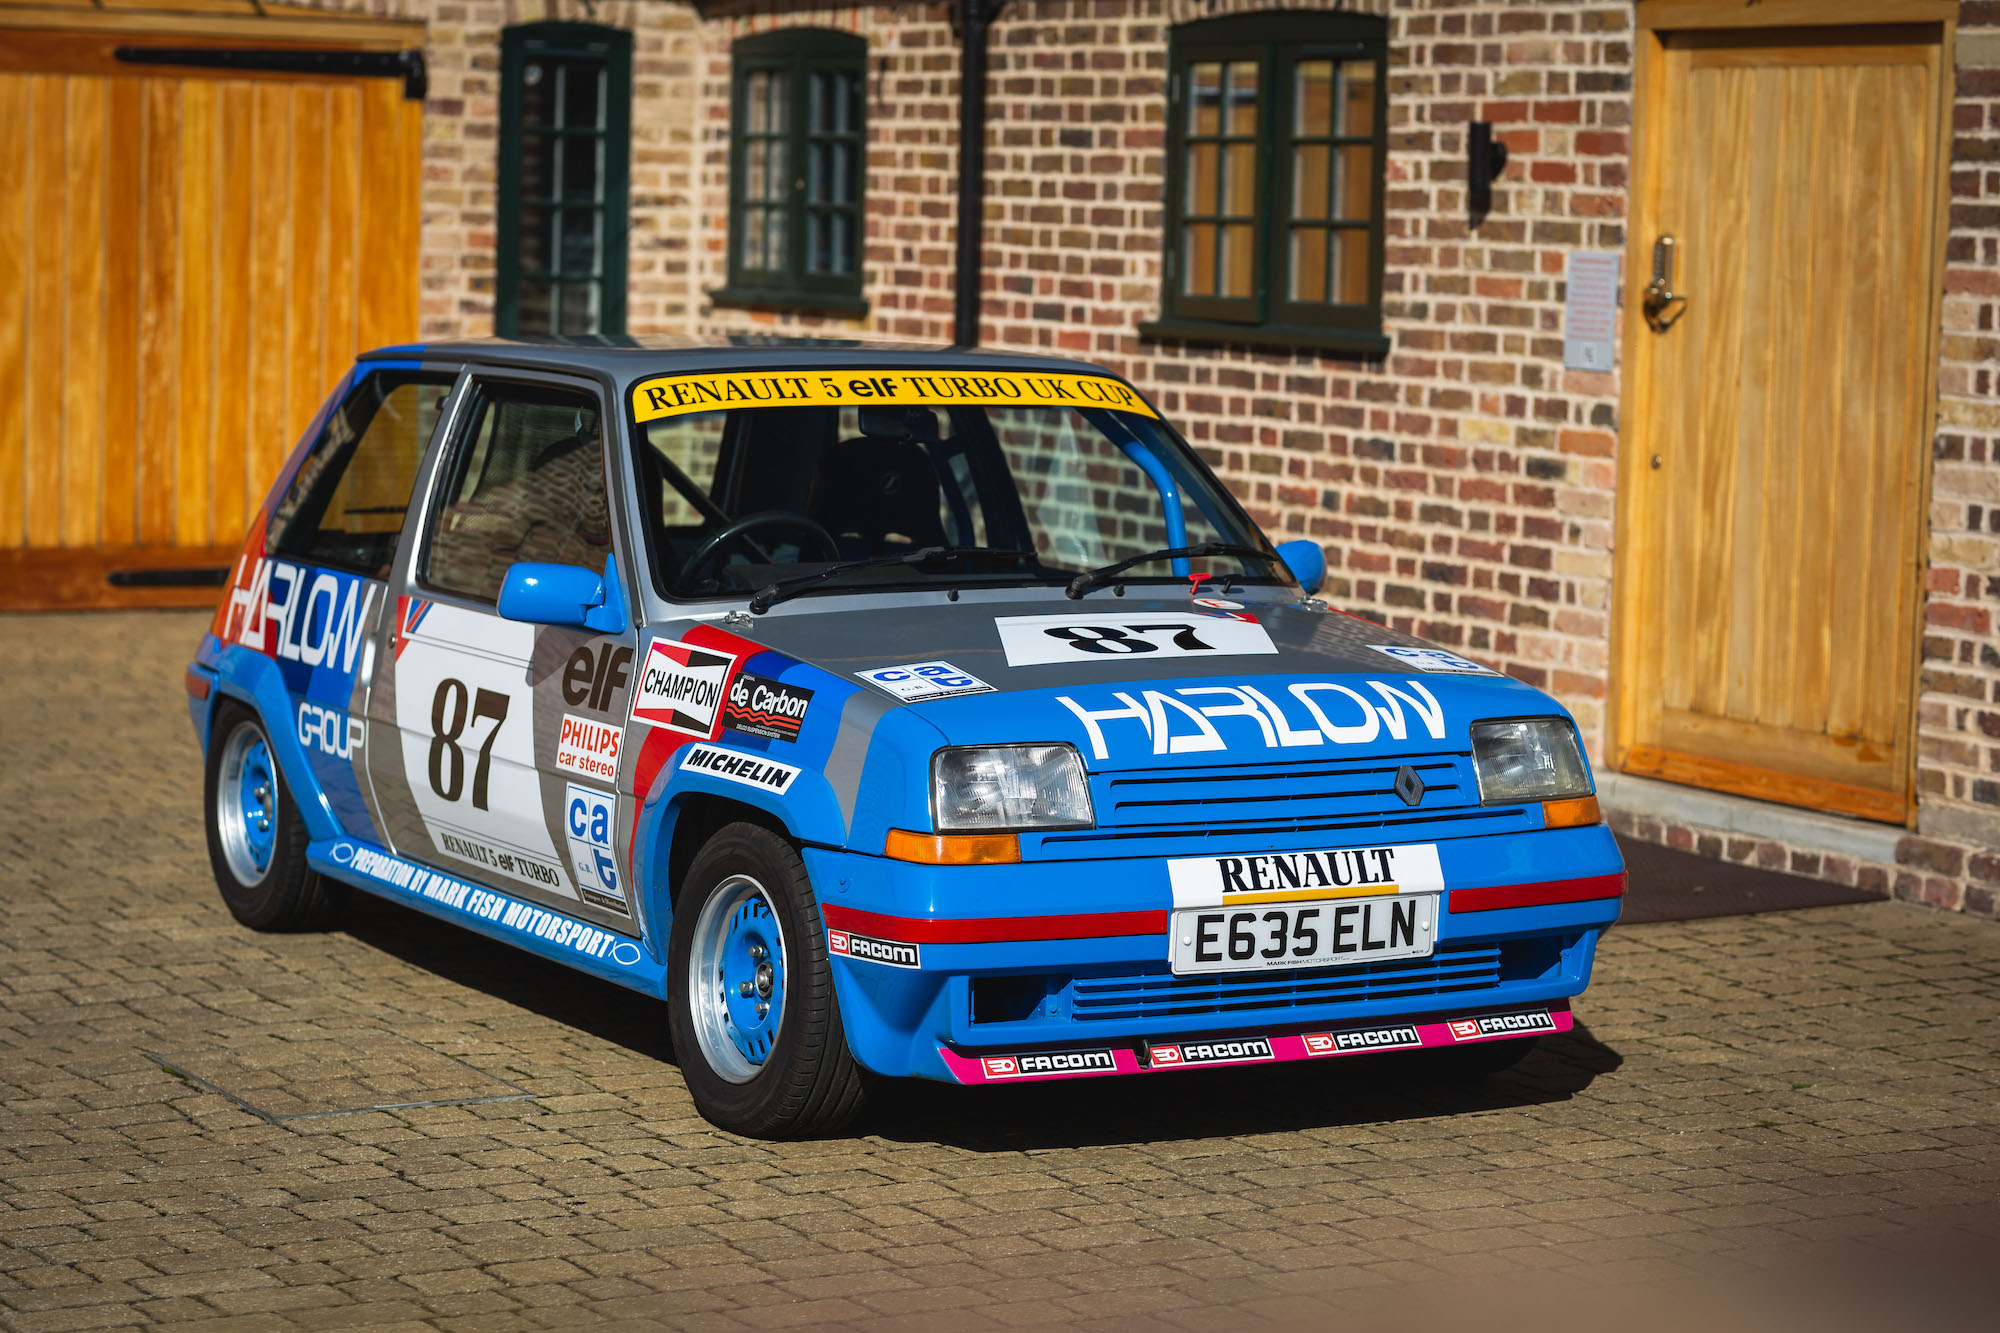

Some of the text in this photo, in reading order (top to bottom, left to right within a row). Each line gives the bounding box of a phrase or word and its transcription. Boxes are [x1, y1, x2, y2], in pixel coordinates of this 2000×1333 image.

[645, 377, 1138, 411] RENAULT 5 elf TURBO UK CUP
[224, 554, 377, 674] HARLOW
[1043, 624, 1216, 654] 87
[562, 643, 634, 712] elf
[644, 668, 718, 708] CHAMPION
[730, 678, 808, 718] de Carbon
[299, 702, 365, 760] GROUP
[561, 719, 620, 758] PHILIPS
[1055, 680, 1445, 759] HARLOW
[429, 678, 510, 812] 87
[559, 751, 614, 778] car stereo
[687, 749, 792, 788] MICHELIN
[441, 832, 560, 887] RENAULT 5 elf TURBO
[1216, 849, 1395, 893] RENAULT
[350, 847, 615, 958] PREPARATION BY MARK FISH MOTORSPORT
[851, 939, 916, 962] FACOM
[1196, 900, 1416, 962] E635 ELN
[1338, 1028, 1416, 1048] FACOM
[1481, 1013, 1551, 1032] FACOM
[1020, 1053, 1111, 1071] FACOM
[1183, 1041, 1269, 1060] FACOM
